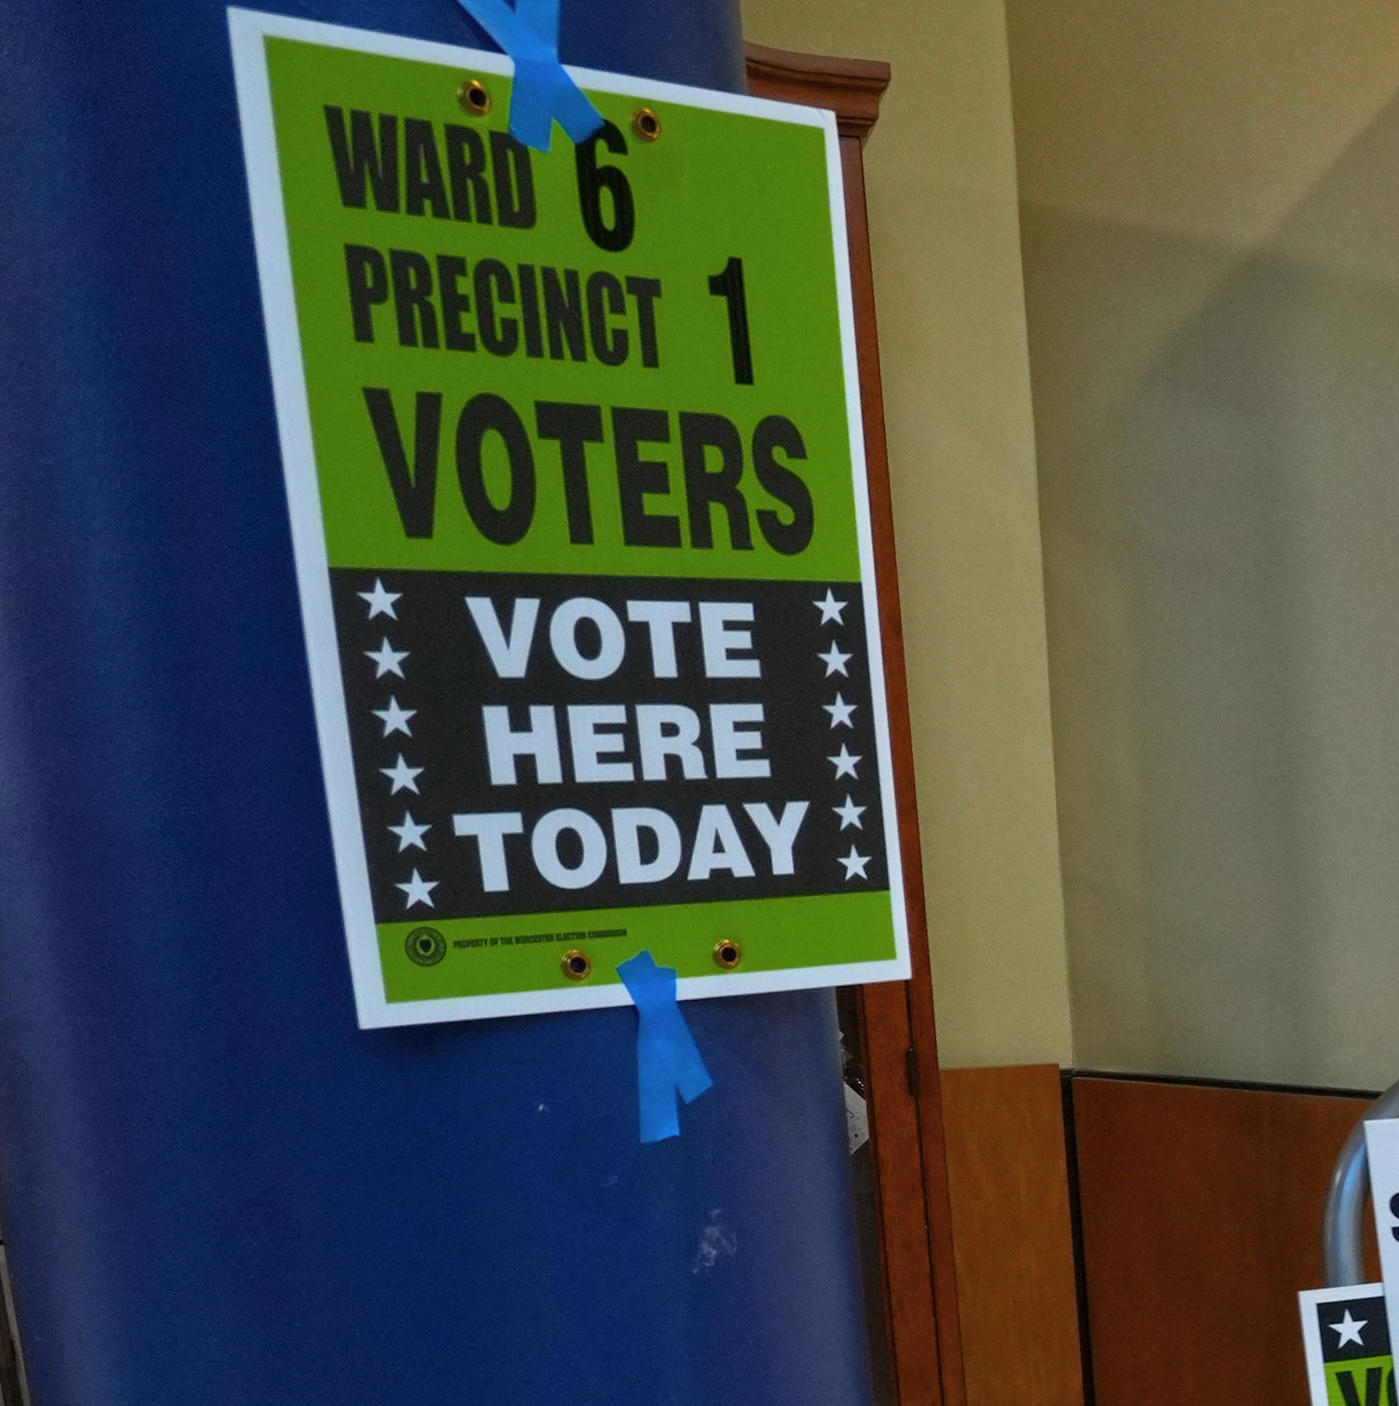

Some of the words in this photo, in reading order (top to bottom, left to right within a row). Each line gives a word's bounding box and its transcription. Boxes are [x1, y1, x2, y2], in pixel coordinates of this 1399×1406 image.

[322, 103, 537, 231] WARD
[575, 120, 636, 254] 6
[343, 243, 663, 370] PRECINCT
[708, 257, 755, 386] 1
[363, 387, 815, 556] VOTERS
[466, 595, 762, 681] VOTE
[482, 703, 771, 786] HERE
[453, 802, 811, 893] TODAY
